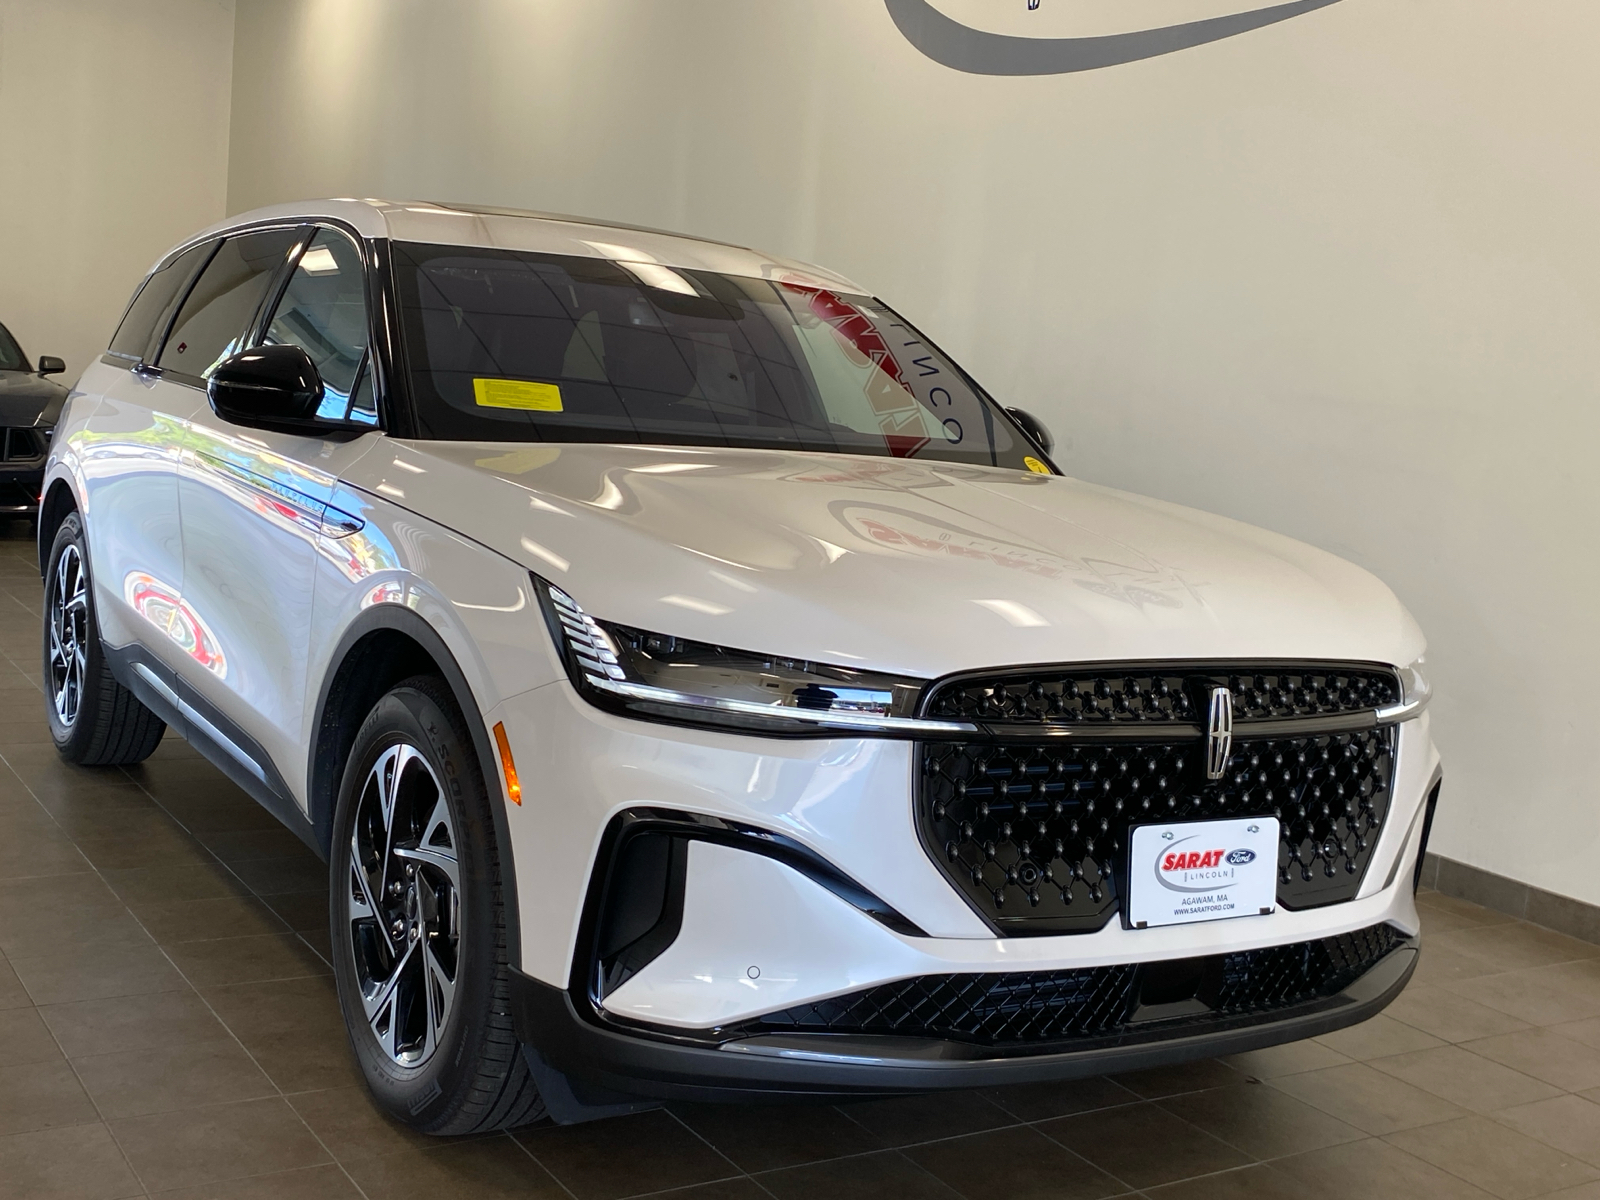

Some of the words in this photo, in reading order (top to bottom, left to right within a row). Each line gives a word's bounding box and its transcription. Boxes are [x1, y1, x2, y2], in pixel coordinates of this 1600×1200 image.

[1162, 849, 1225, 871] SARAT
[1230, 850, 1252, 863] Ford
[1190, 870, 1228, 880] LINCOLN
[1181, 896, 1215, 906] AGAWAM,
[1217, 894, 1228, 902] MA
[1174, 903, 1235, 915] WWW.SARATFORD.COM
